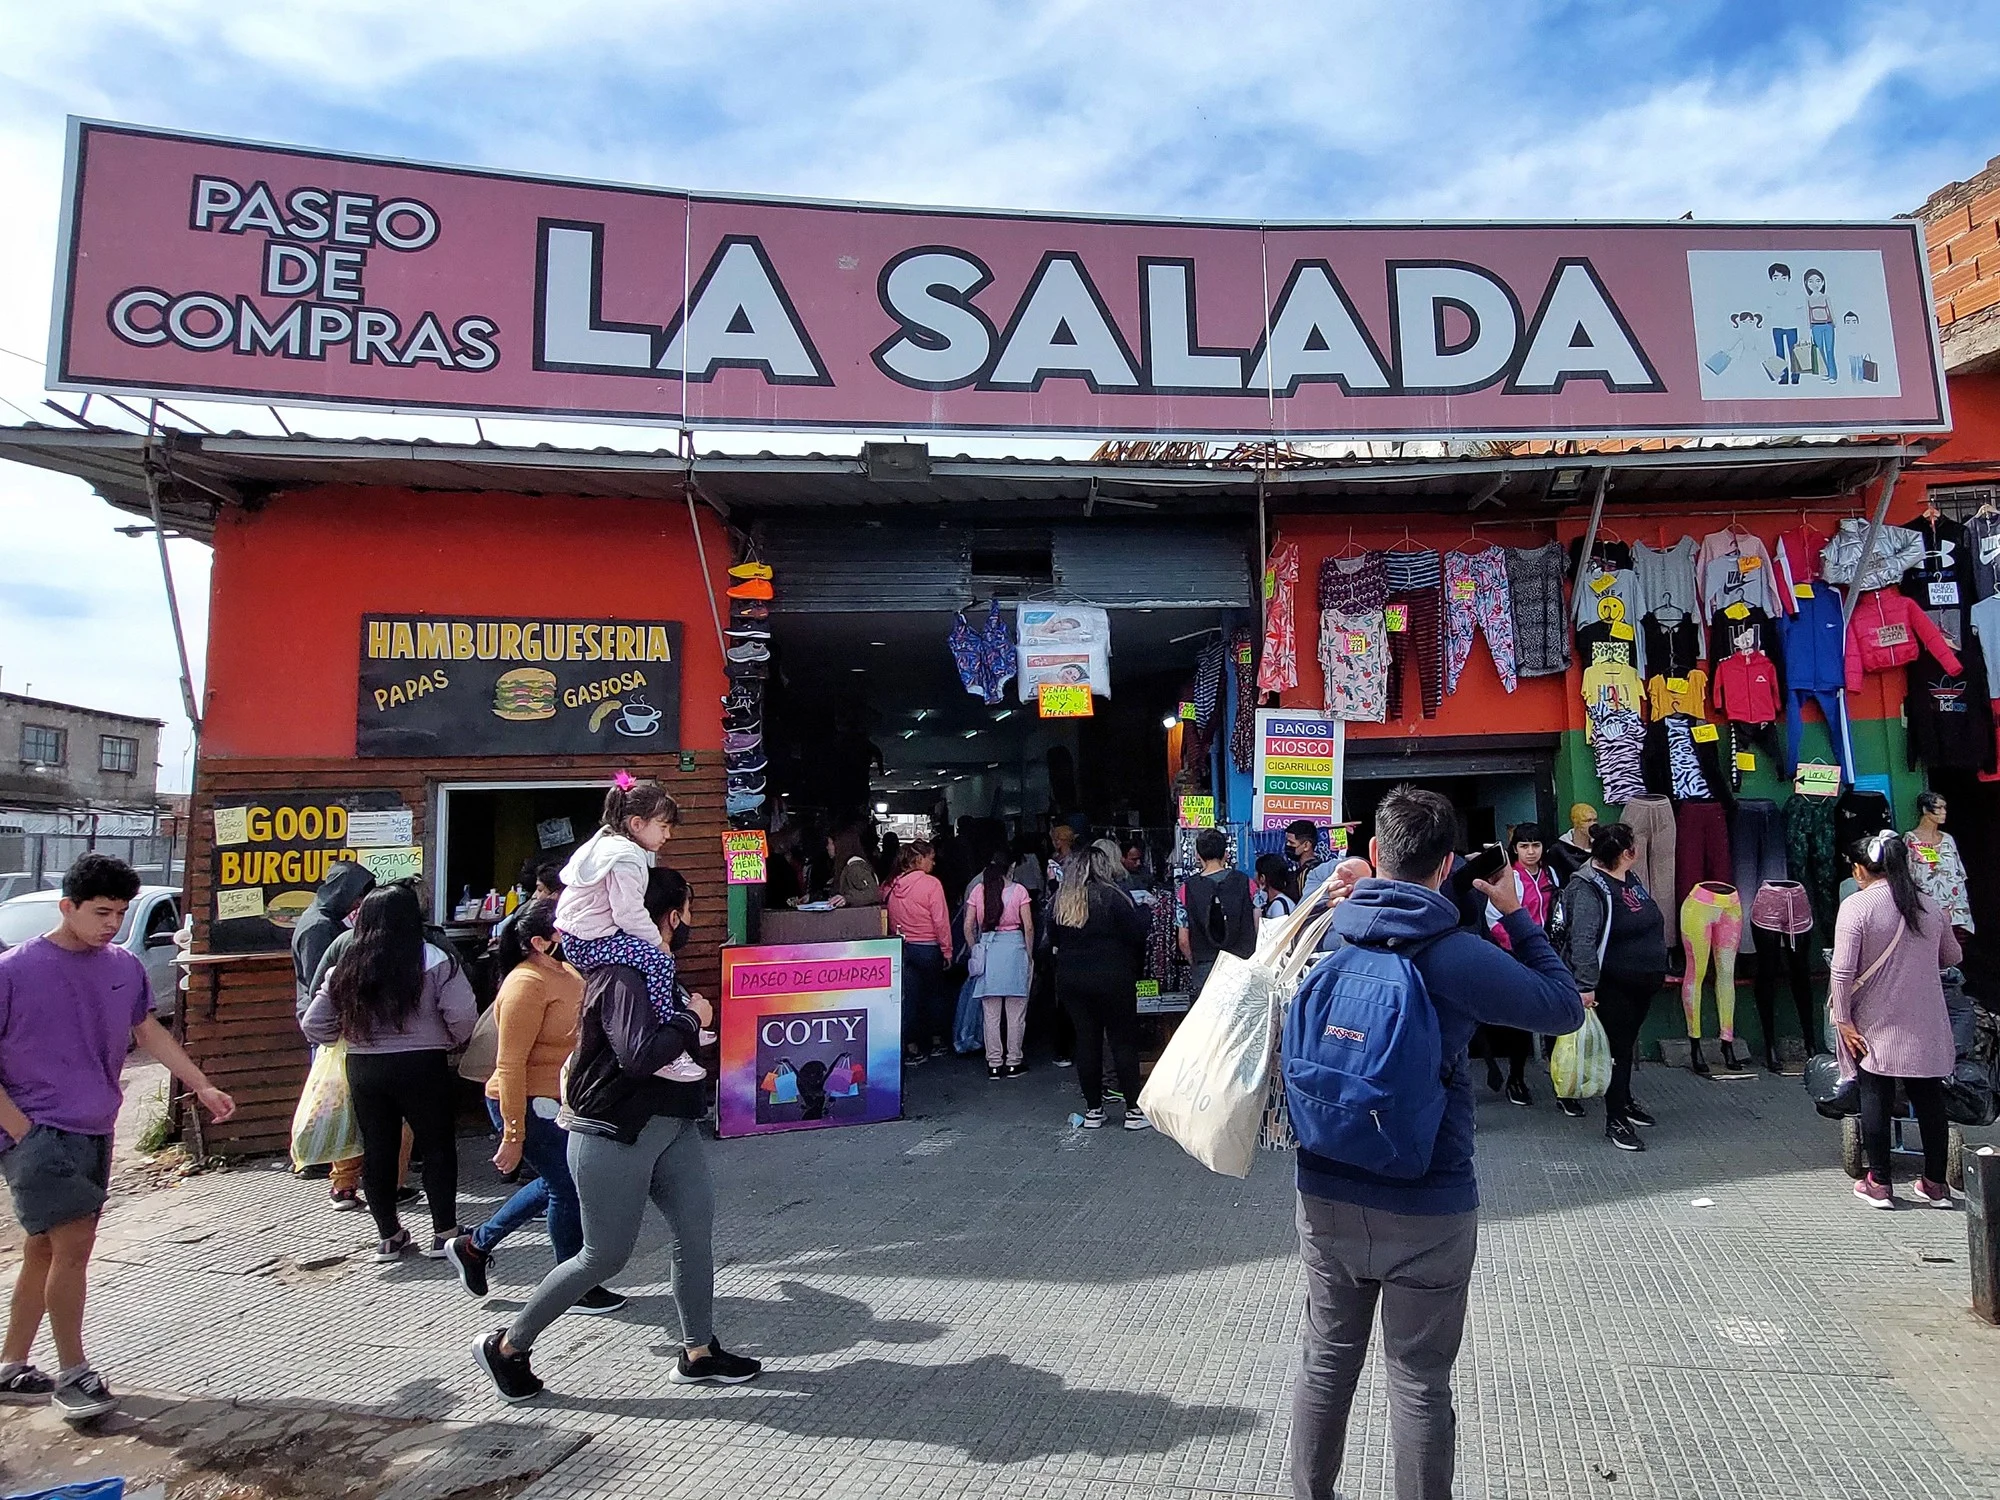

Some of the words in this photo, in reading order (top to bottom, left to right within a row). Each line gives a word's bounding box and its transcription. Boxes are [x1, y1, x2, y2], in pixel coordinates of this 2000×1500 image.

[195, 176, 440, 251] PASEO
[264, 241, 365, 304] DE
[534, 218, 834, 387] LA
[871, 245, 1666, 397] SALADA
[108, 287, 499, 371] COMPRAS
[1594, 589, 1616, 600] HAVE
[368, 620, 673, 662] HAMBURGUESERIA
[373, 669, 449, 711] PAPAS
[563, 670, 648, 709] GASEOSA
[1042, 685, 1068, 694] VENTA
[1043, 693, 1073, 702] MAYOR
[1275, 722, 1327, 736] BAÑOS
[1271, 740, 1329, 755] KIOSCO
[1267, 761, 1330, 772] CIGARRILLOS
[1269, 780, 1329, 792] GOLOSINAS
[1267, 799, 1329, 811] GALLETITAS
[247, 806, 347, 842] GOOD
[754, 840, 761, 851] 2
[365, 851, 422, 867] TOSTADOS
[741, 971, 787, 990] PASEO
[793, 970, 813, 985] DE
[817, 964, 886, 985] COMPRAS
[762, 1016, 864, 1047] COTY
